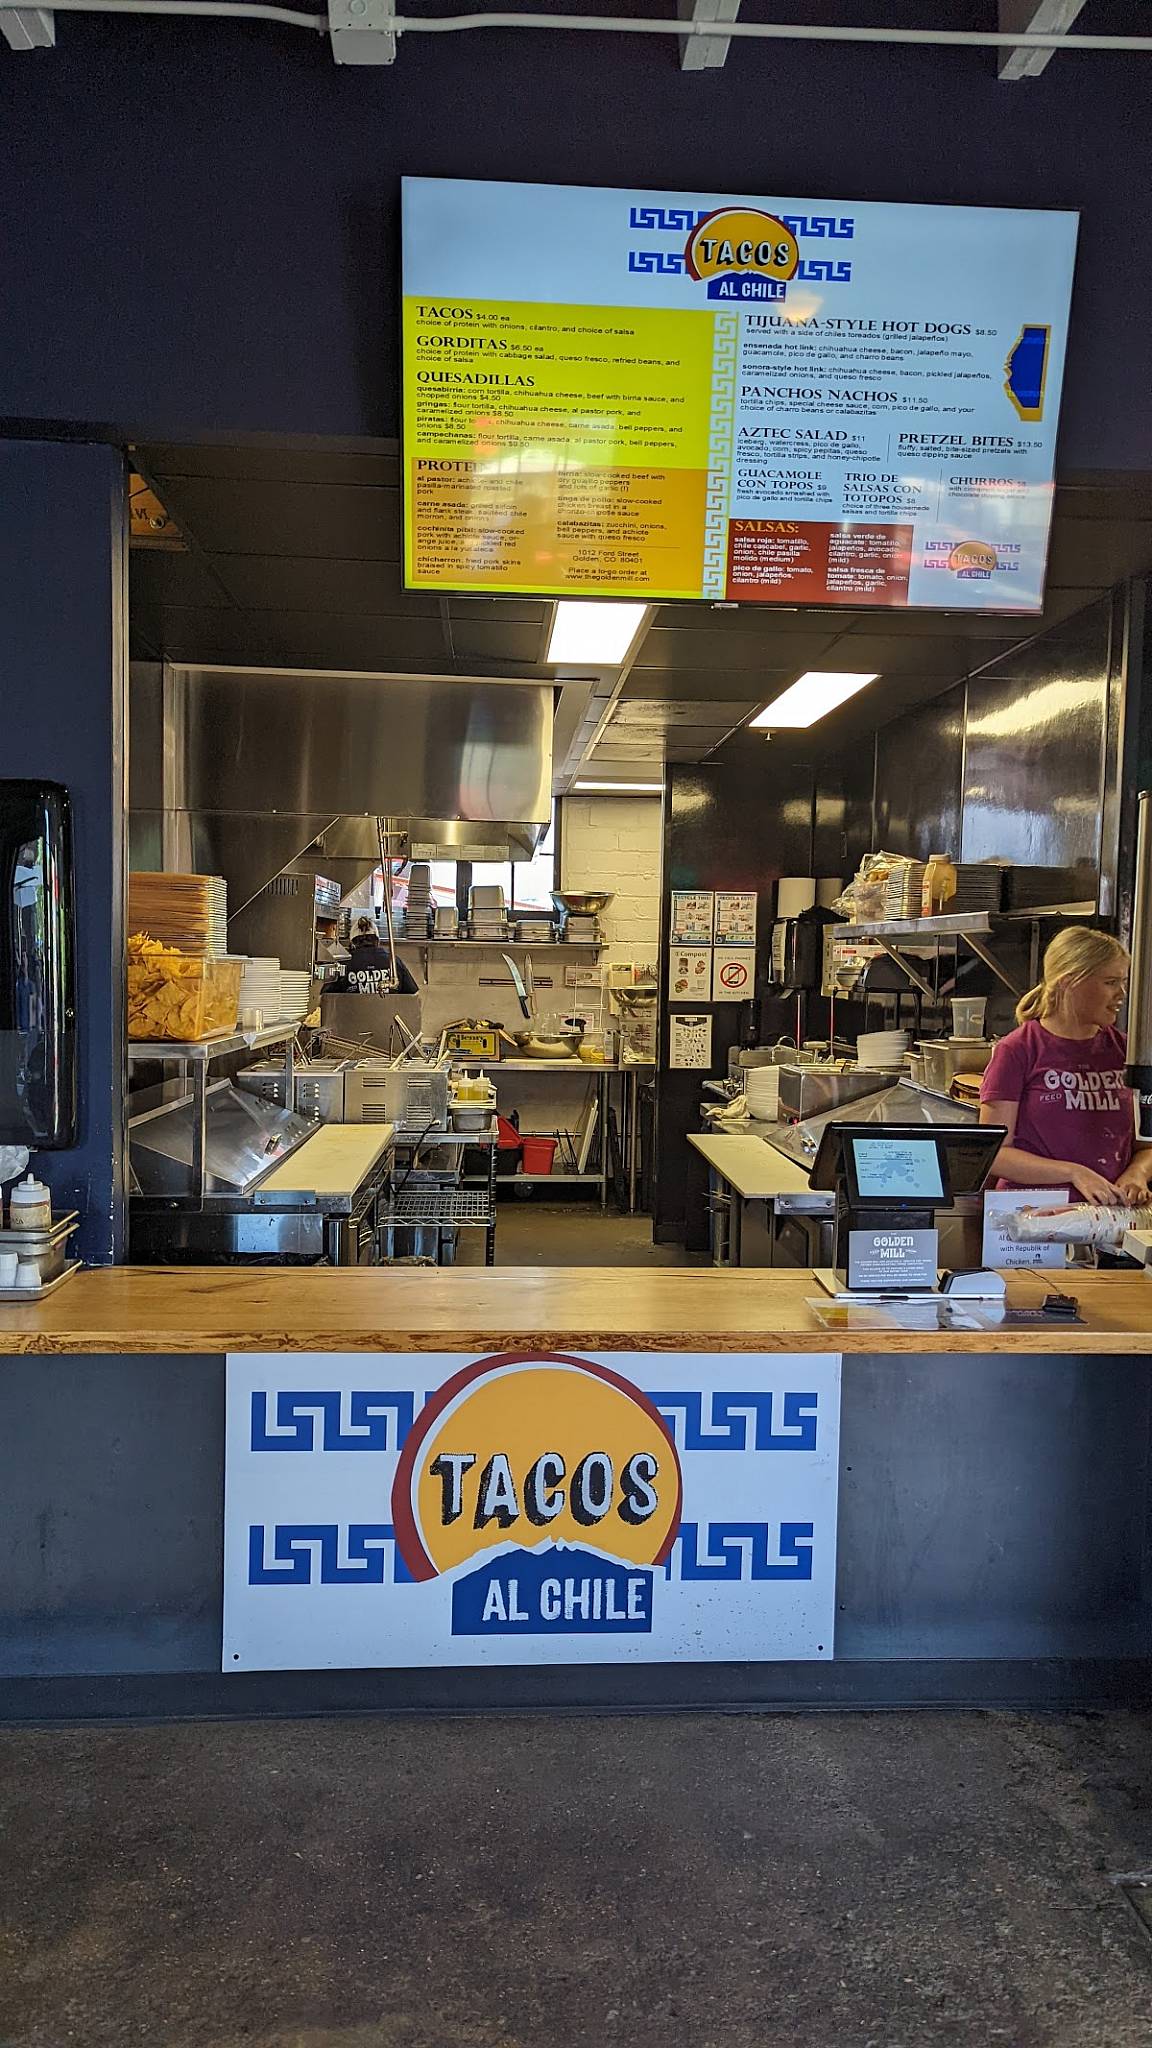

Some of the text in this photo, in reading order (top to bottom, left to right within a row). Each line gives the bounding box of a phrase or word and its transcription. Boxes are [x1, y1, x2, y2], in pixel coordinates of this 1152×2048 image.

[700, 239, 790, 266] TACOS
[719, 282, 785, 298] AL CHILE
[416, 306, 473, 319] TACOS
[745, 315, 877, 331] TIJUANA-STYLE
[882, 321, 919, 332] HOT
[925, 322, 971, 335] DOGS
[416, 335, 507, 350] GORDITAS
[909, 334, 948, 342] jalapeños)
[499, 352, 532, 360] cabbage
[916, 349, 949, 357] jalapeño
[416, 371, 535, 386] QUESADILLAS
[416, 392, 450, 400] chopped
[742, 386, 822, 399] PANCHOS
[828, 389, 898, 402] NACHOS
[738, 427, 790, 439] AZTEC
[795, 429, 847, 441] SALAD
[899, 433, 966, 445] PRETZEL
[972, 436, 1013, 447] BITES
[738, 469, 822, 480] GUACAMOLE
[844, 472, 898, 483] TRIO DE
[950, 476, 1013, 486] CHURROS
[737, 479, 766, 488] CON
[771, 480, 813, 490] TOPOS
[843, 484, 921, 494] SALSAS CON
[844, 494, 902, 504] TOTOPOS
[735, 520, 799, 534] SALSAS:
[956, 554, 992, 564] TACOS
[348, 969, 391, 984] GOLDE
[1064, 1090, 1120, 1110] MILL
[873, 1236, 913, 1246] GOLDEN
[880, 1248, 905, 1258] MILL
[428, 1450, 660, 1530] TACOS
[482, 1576, 647, 1623] AL CHILE
